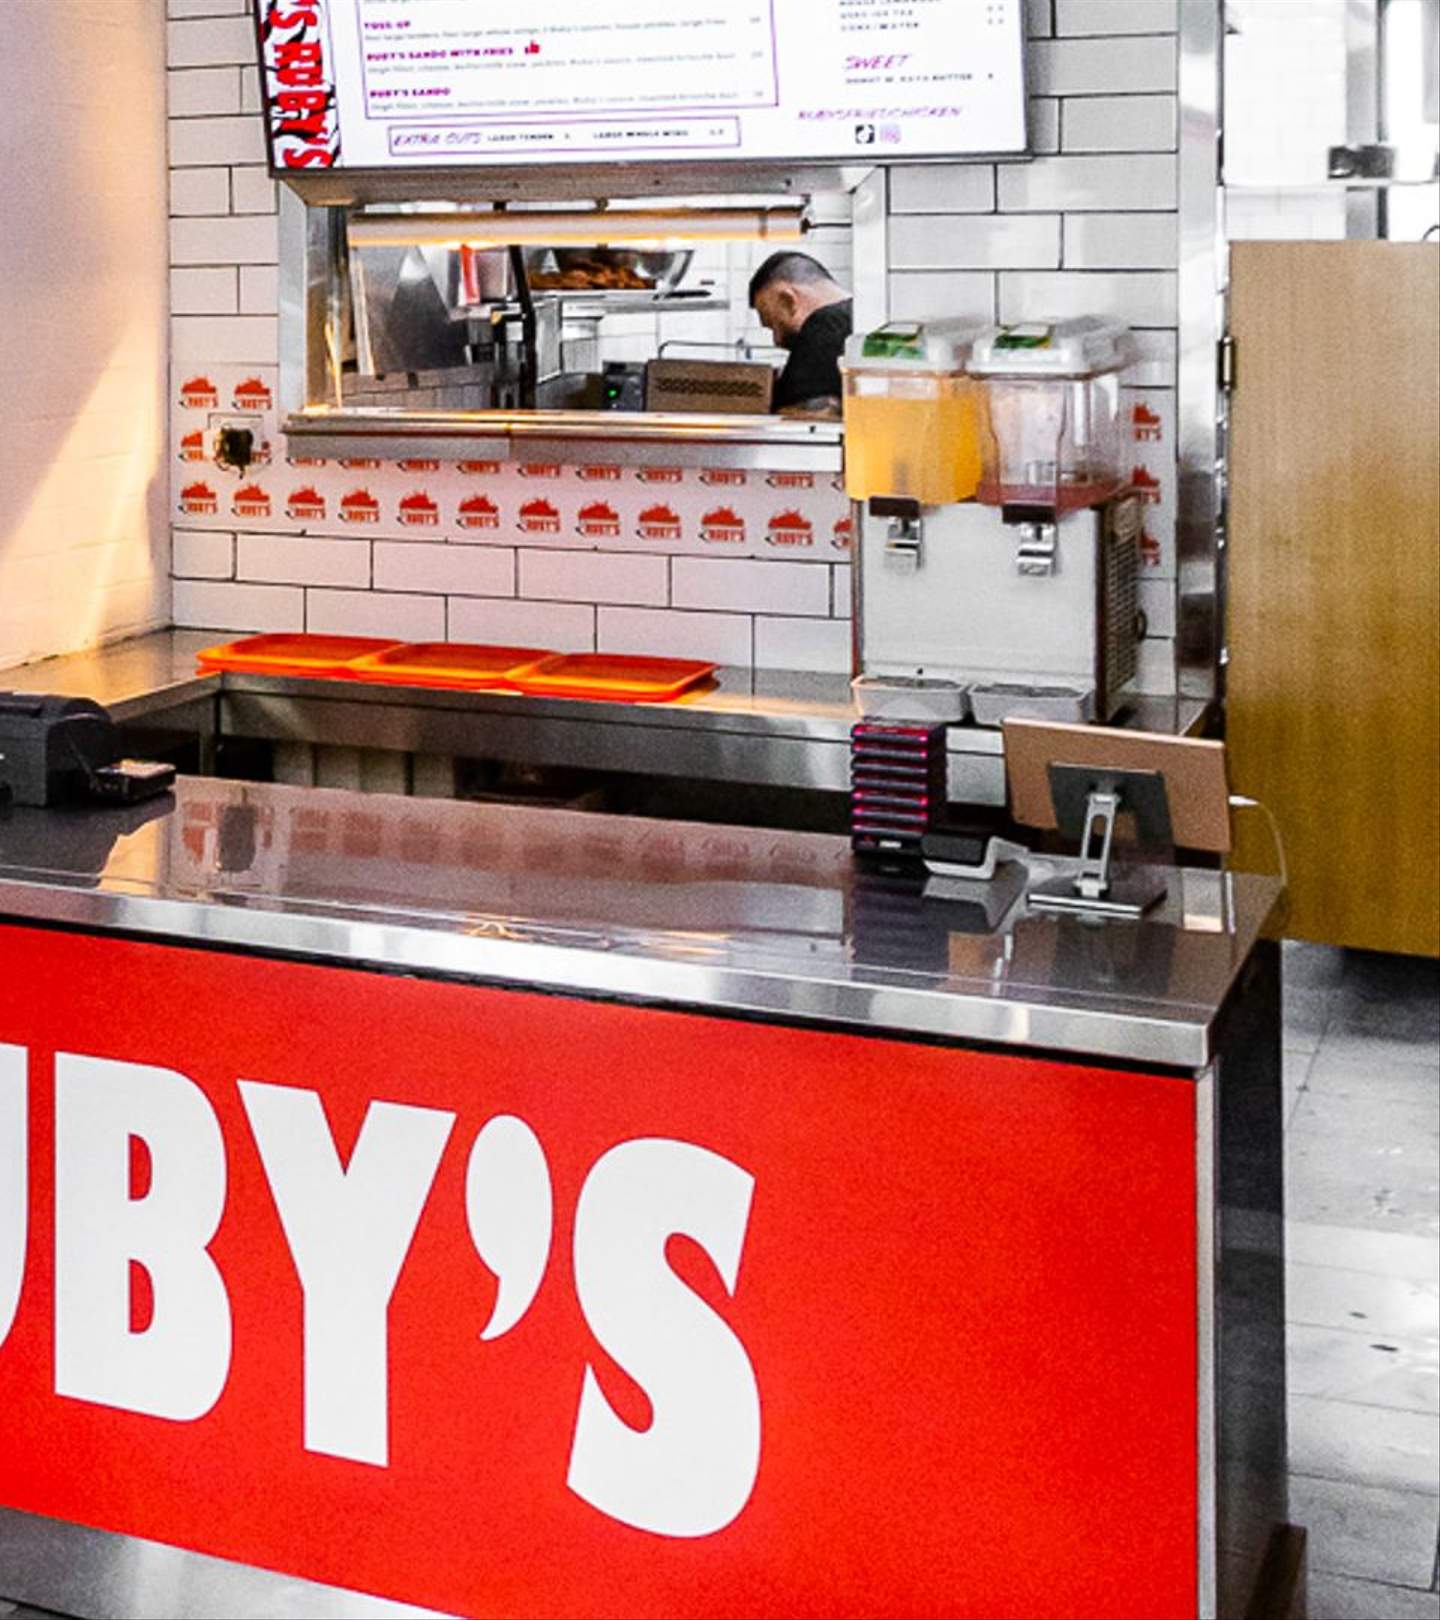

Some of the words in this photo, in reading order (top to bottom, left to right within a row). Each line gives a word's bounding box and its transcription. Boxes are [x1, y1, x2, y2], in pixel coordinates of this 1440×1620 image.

[844, 53, 913, 70] SWEET
[274, 41, 333, 168] RUBY'S
[393, 134, 441, 146] EXTRA
